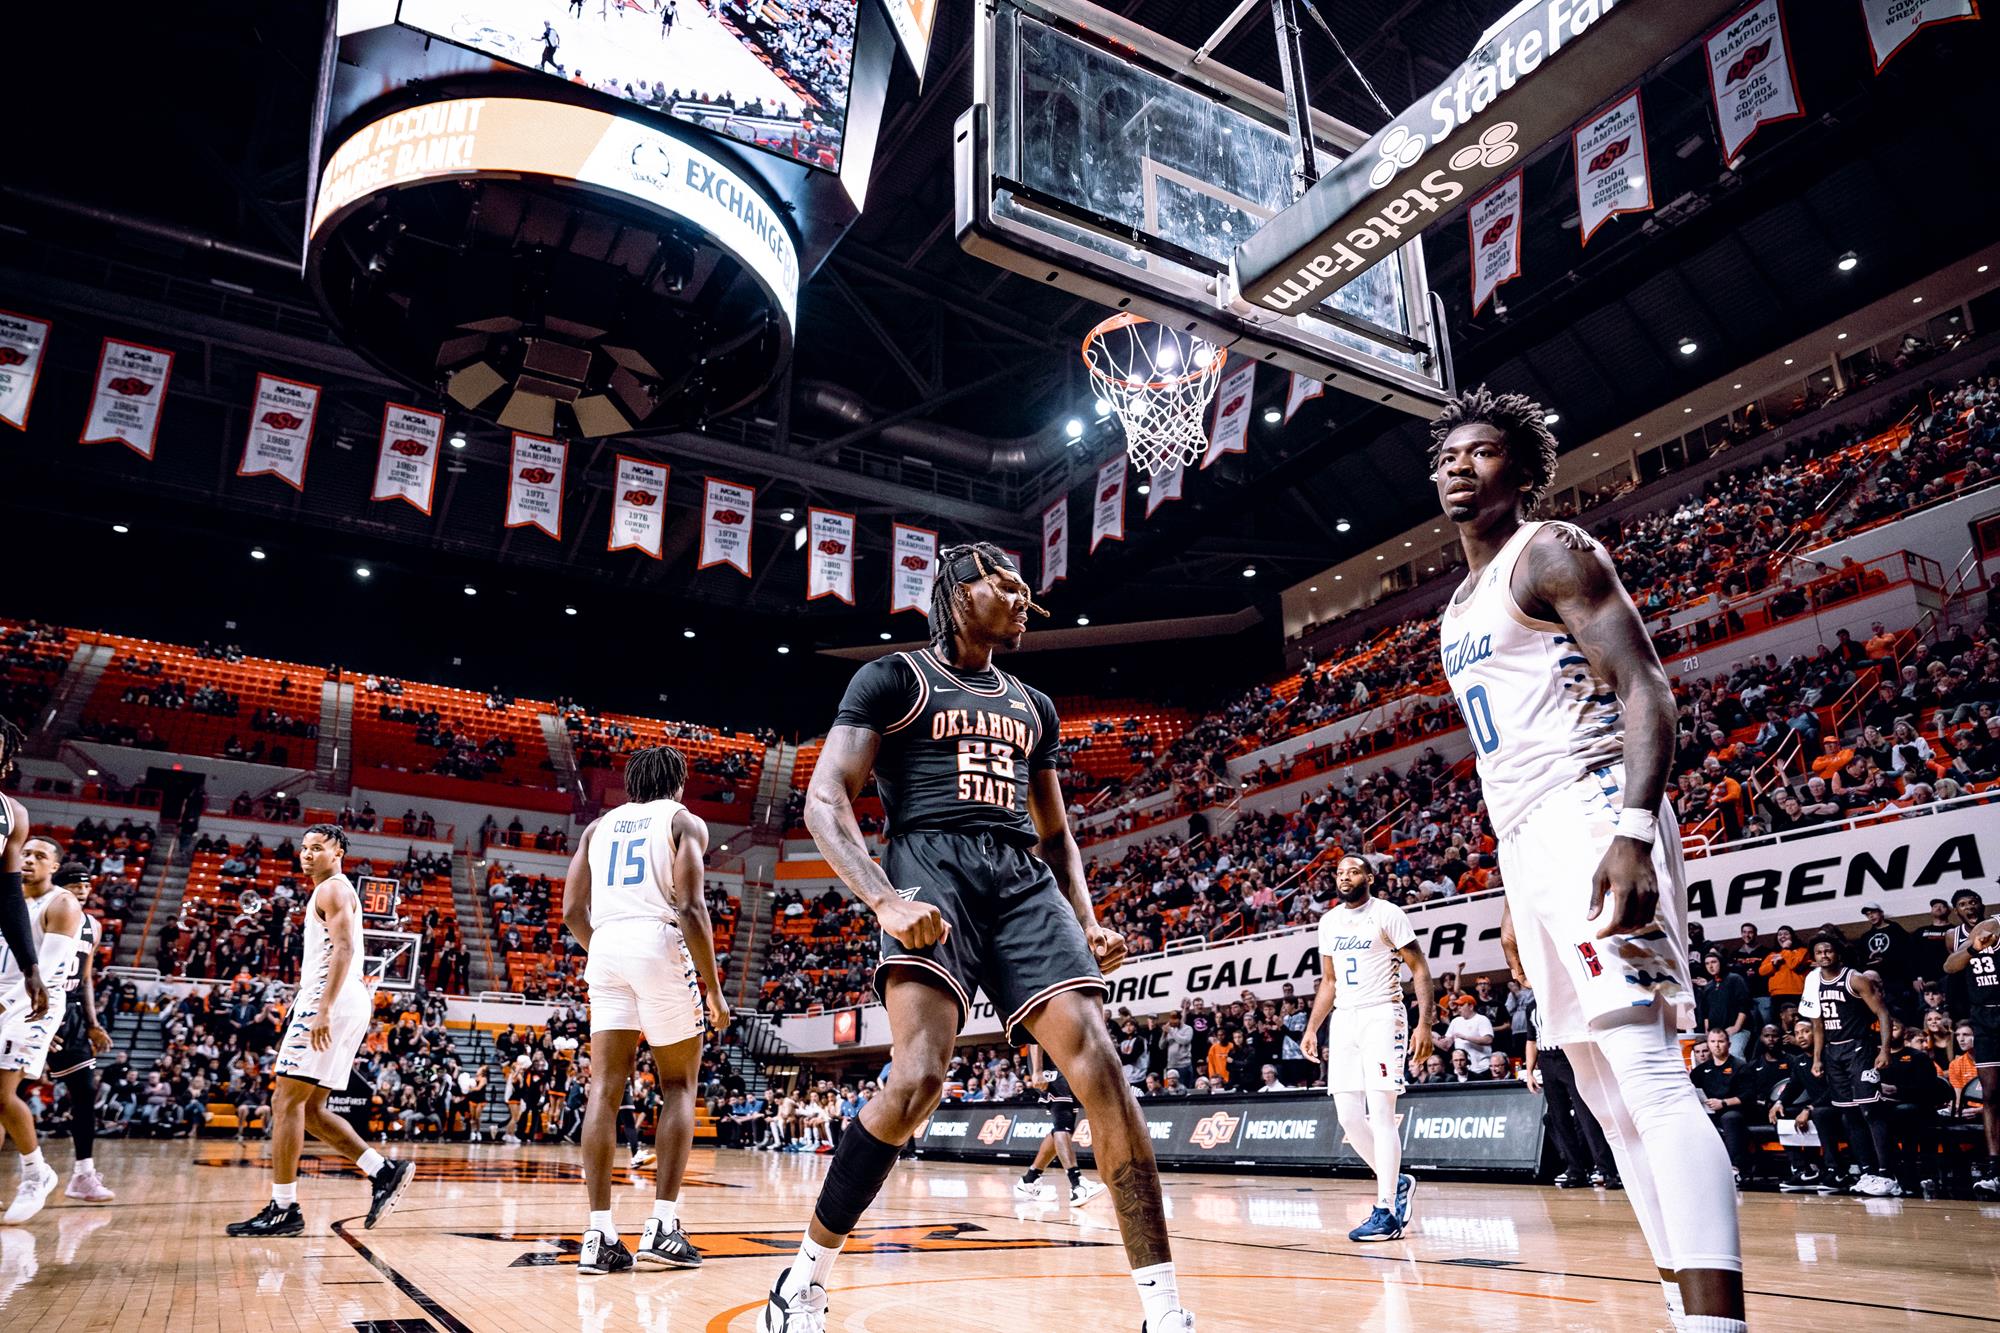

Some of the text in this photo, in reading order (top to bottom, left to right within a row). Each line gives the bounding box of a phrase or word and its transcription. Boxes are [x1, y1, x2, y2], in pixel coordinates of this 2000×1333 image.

[1714, 12, 1777, 62] CHAMPIONS
[1727, 12, 1760, 41] NCAA
[1738, 73, 1768, 101] 2005
[374, 100, 485, 149] ACCOUNT
[1580, 111, 1636, 152] CHAMPIONS
[1593, 111, 1622, 135] NCAA
[394, 134, 475, 178] BANK!
[1594, 175, 1630, 199] COWBOY
[1597, 167, 1625, 189] 2004
[686, 157, 784, 263] EXCHANGE
[516, 449, 561, 464] CHAMPIONS
[529, 443, 552, 454] NCAA
[621, 472, 663, 487] CHAMPIONS
[632, 466, 654, 477] NCAA
[525, 489, 545, 500] 1971
[1443, 631, 1493, 678] Tulsa
[1683, 656, 1698, 672] 213
[932, 709, 1034, 758] OKLAHOMA
[957, 739, 1015, 779] 23
[957, 773, 1016, 810] STATE
[607, 838, 646, 886] 15
[1687, 833, 1985, 919] ARENA
[363, 893, 388, 913] 30
[1333, 936, 1372, 951] Tulsa
[1345, 958, 1359, 985] 2
[1969, 956, 1996, 975] 33
[1976, 974, 1999, 987] STATE
[1821, 1001, 1839, 1018] 51
[327, 1105, 351, 1113] BANK
[1189, 1111, 1240, 1149] OSU
[1245, 1119, 1318, 1140] MEDICINE
[1413, 1116, 1507, 1140] MEDICINE
